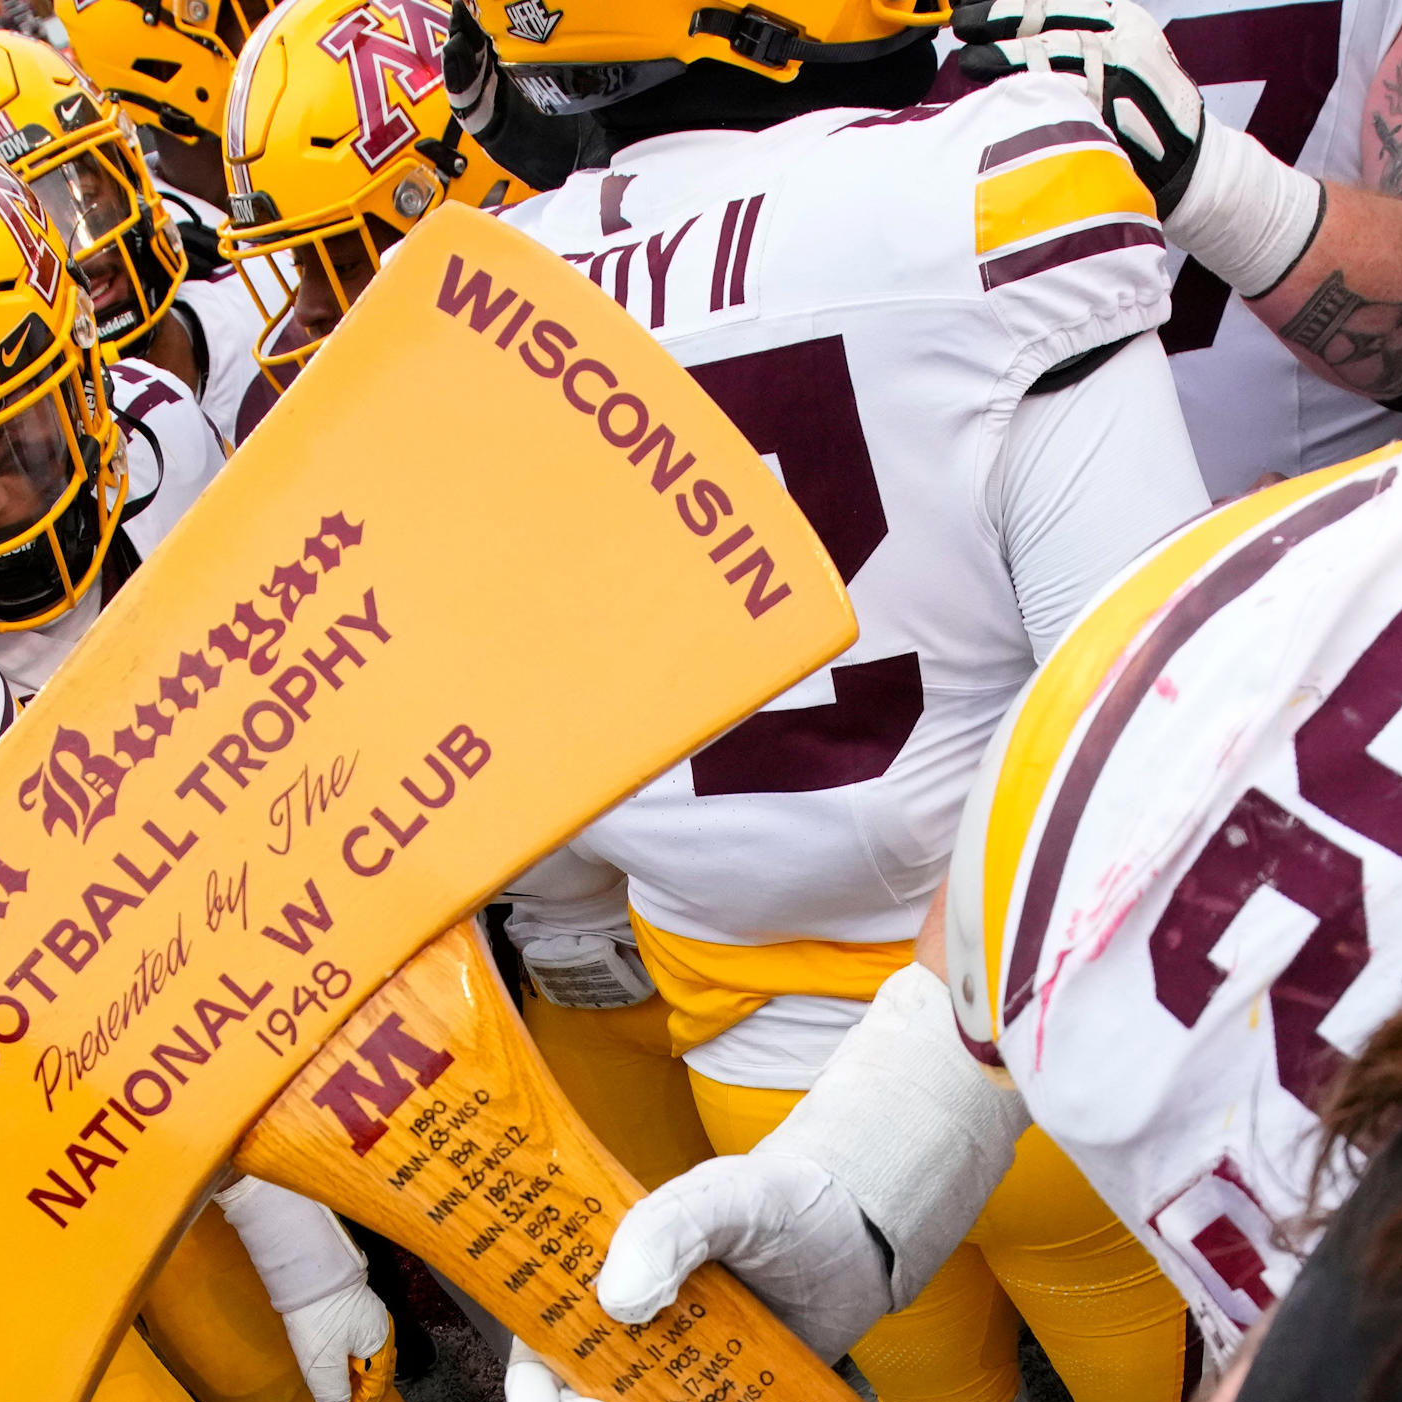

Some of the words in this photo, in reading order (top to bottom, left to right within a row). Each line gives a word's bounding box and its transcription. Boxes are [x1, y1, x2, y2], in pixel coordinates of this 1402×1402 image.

[316, 0, 452, 173] M
[435, 253, 793, 620] WISCONSIN
[19, 510, 366, 845] Bunyan
[175, 587, 393, 815] TROPHY
[32, 919, 194, 1112] Presented
[206, 862, 250, 931] by
[267, 747, 360, 855] The
[26, 972, 274, 1229] NATIONAL
[261, 878, 335, 957] W
[342, 723, 492, 877] CLUB
[255, 960, 353, 1057] 1948
[310, 1013, 456, 1158] M
[408, 1099, 447, 1138] 1890
[387, 1148, 432, 1191] MINN.
[447, 1137, 480, 1169] 1891
[483, 1168, 524, 1207] 1892
[465, 1219, 507, 1260] MINN.
[523, 1203, 561, 1240] 1893
[557, 1239, 594, 1275] 1895
[610, 1356, 654, 1395] MINN.
